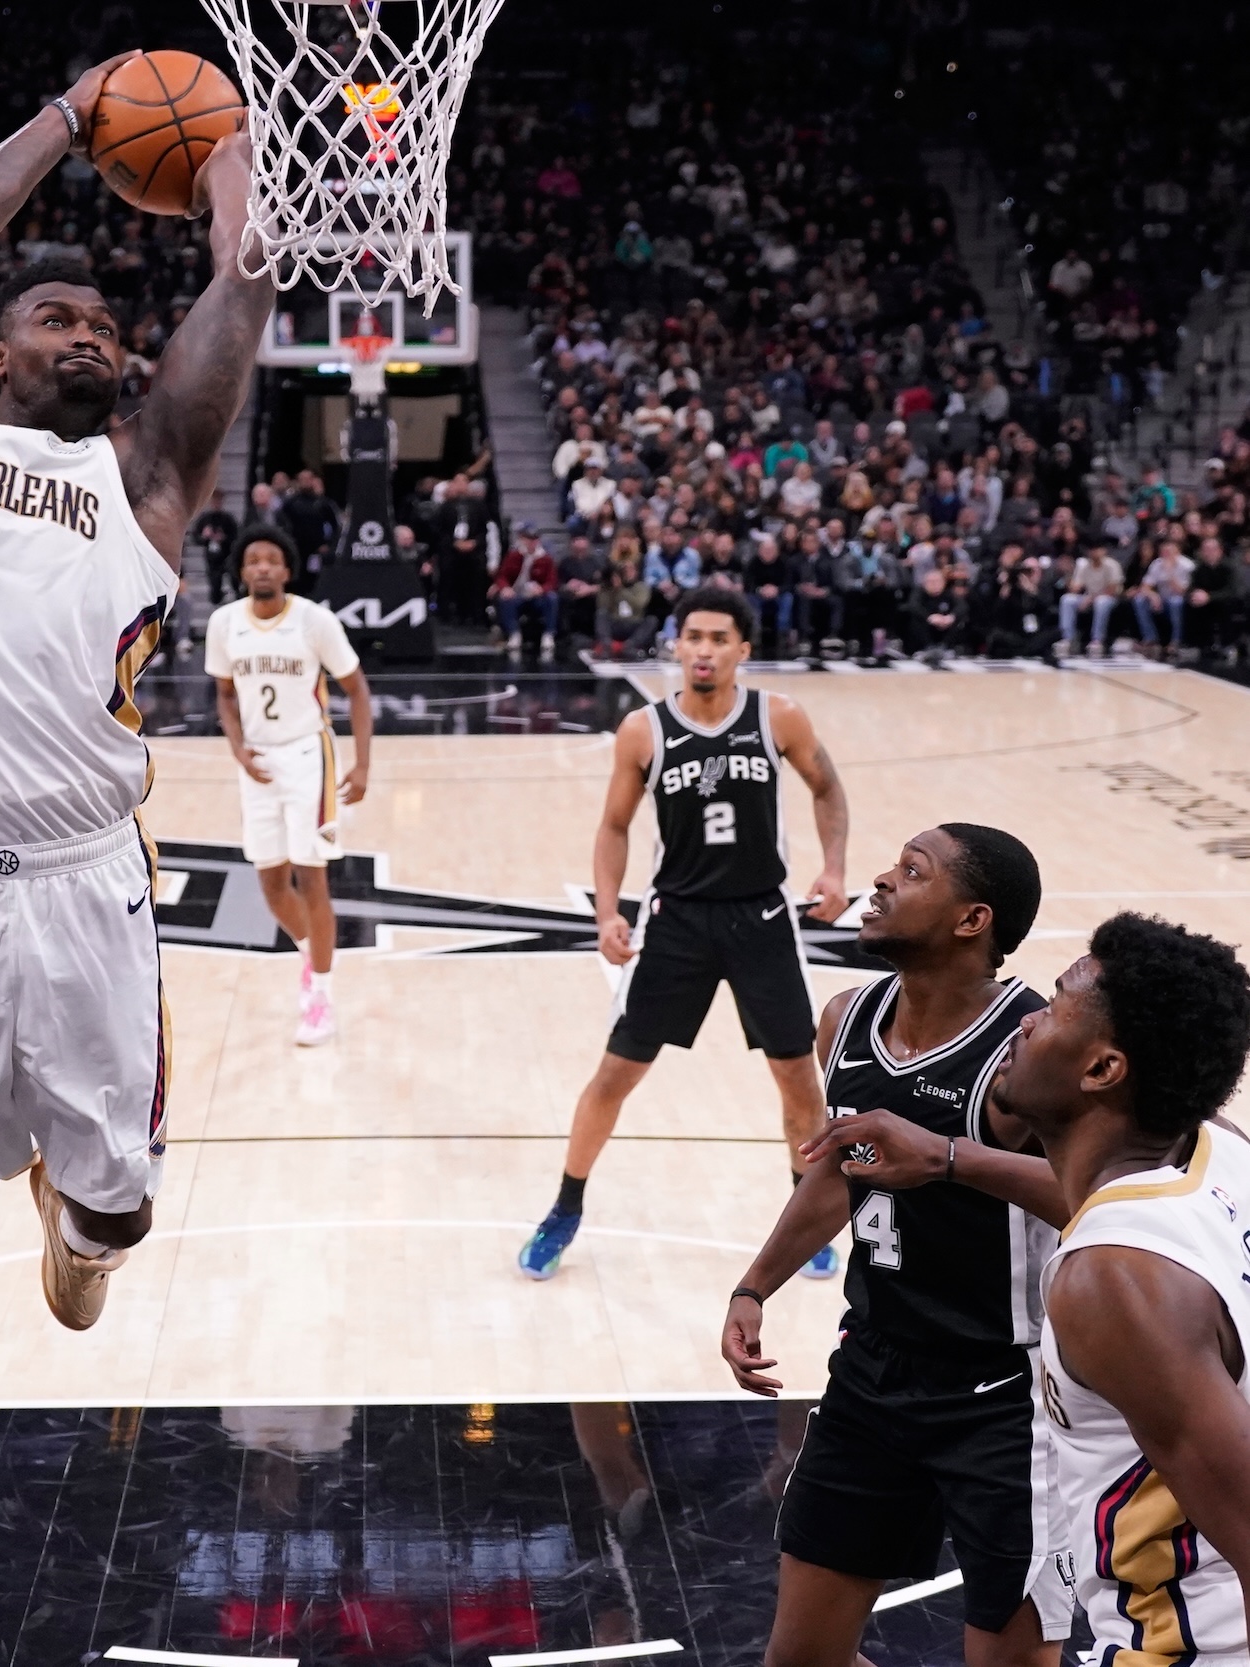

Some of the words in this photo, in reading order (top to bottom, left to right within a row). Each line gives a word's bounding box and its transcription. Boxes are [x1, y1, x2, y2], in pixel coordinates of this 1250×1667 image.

[260, 684, 279, 721] 2
[661, 754, 770, 798] SPURS
[702, 801, 737, 845] 2
[920, 1083, 958, 1102] LEDGER
[852, 1190, 902, 1271] 4
